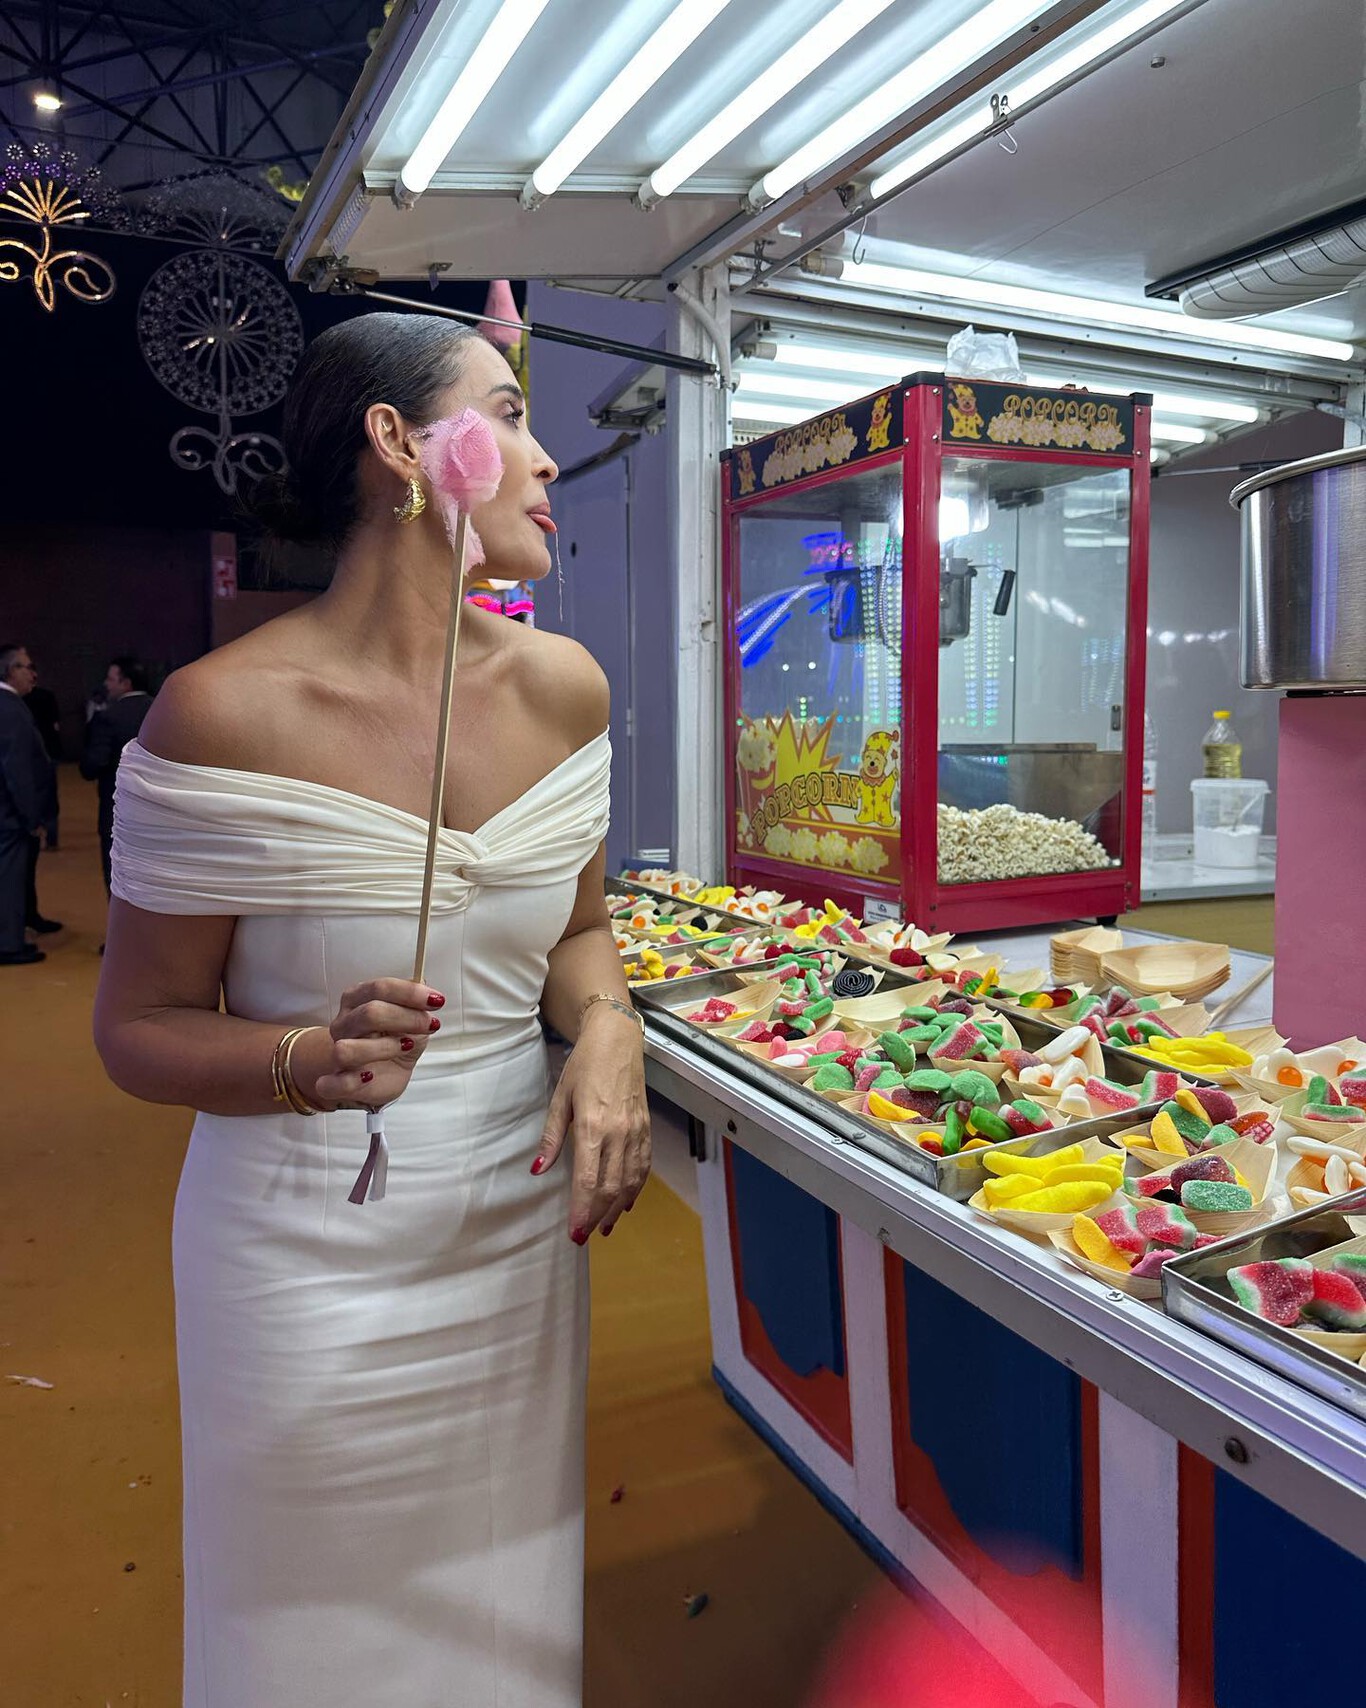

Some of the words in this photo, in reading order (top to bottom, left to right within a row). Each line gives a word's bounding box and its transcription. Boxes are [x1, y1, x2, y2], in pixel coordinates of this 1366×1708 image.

[1003, 394, 1118, 426] POPCORN
[774, 413, 847, 456] POPCORN
[750, 772, 860, 845] POPCORN
